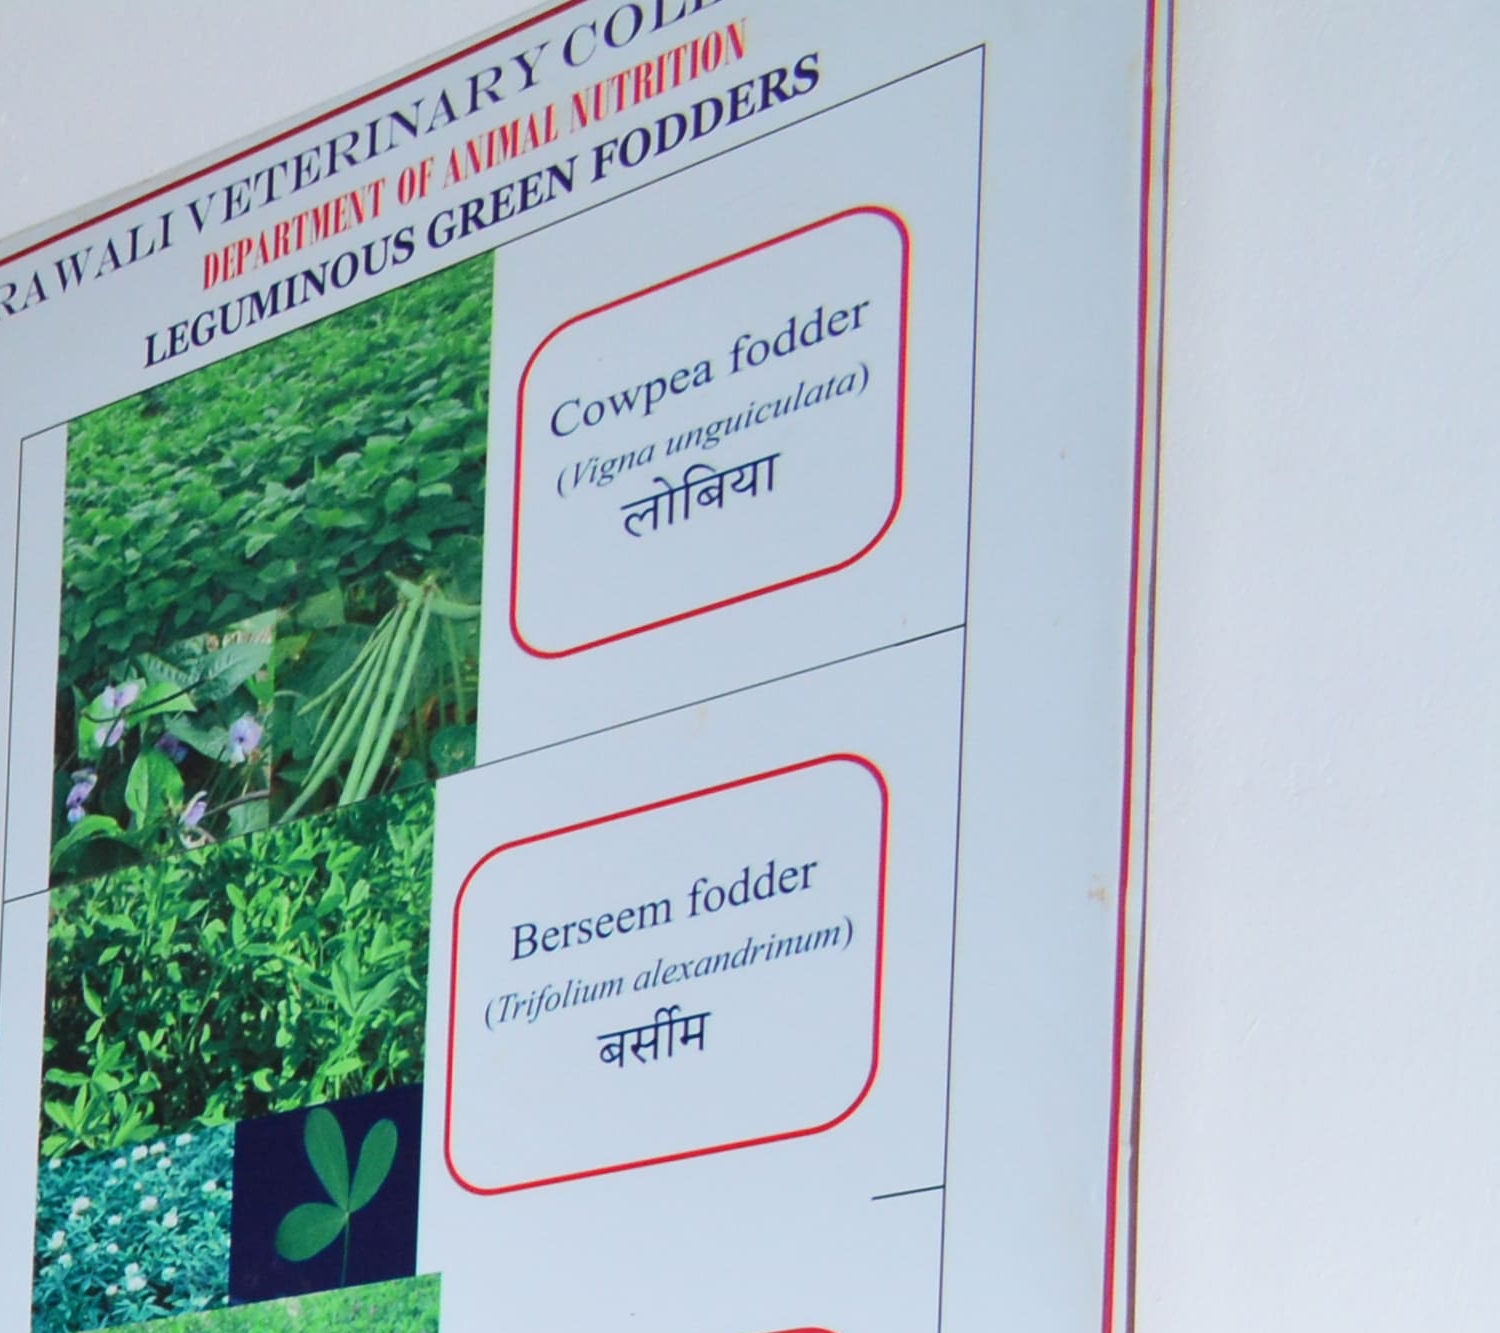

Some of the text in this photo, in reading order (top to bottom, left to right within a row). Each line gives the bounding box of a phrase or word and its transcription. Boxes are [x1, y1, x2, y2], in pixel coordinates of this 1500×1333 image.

[186, 41, 550, 233] VETERINARY
[202, 17, 748, 291] DEPARTMENT OF ANIMAL NUTRITION
[143, 52, 821, 368] LEGUMINOUS GREEN FODDERS
[550, 300, 871, 437] Cowpea fodder
[556, 361, 871, 498] (Vigna unguiculata)
[620, 453, 782, 538] लोबिया
[484, 914, 854, 1031] (Trifolium alexandrinum)
[511, 859, 819, 961] Berseem fodder
